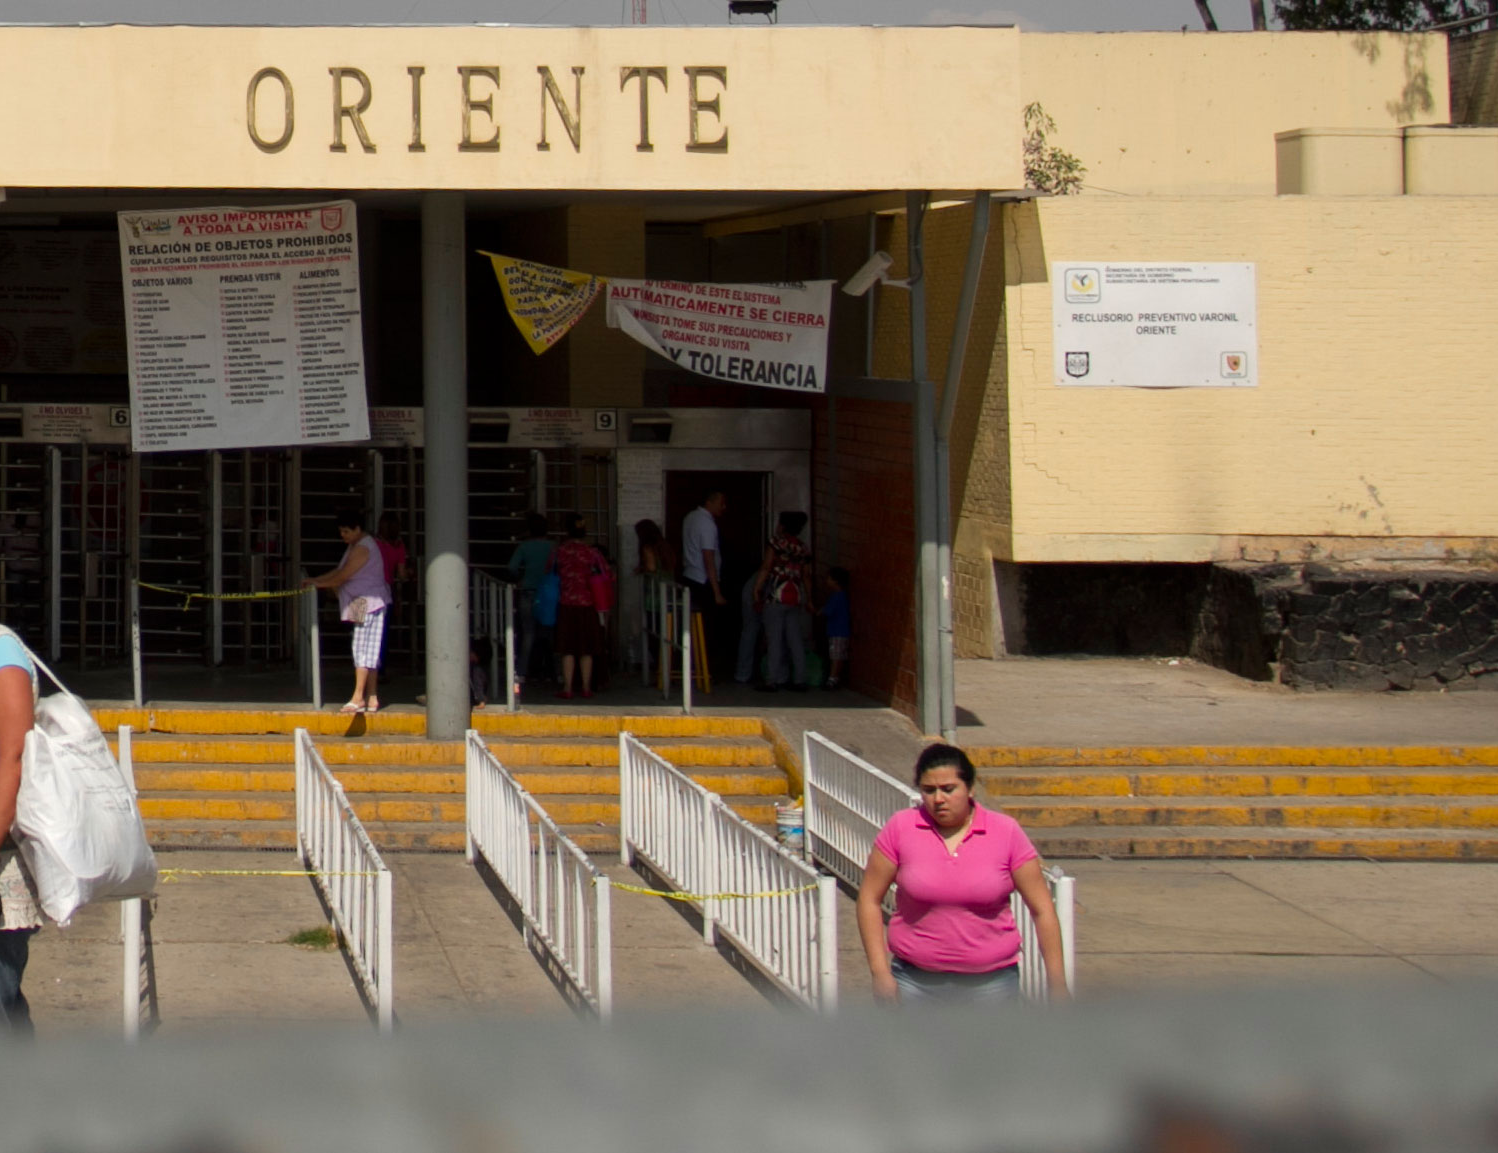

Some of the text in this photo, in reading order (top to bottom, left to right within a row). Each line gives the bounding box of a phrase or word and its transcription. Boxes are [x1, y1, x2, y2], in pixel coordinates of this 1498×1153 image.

[246, 65, 730, 153] ORIENTE
[177, 210, 312, 225] AVISO IMPORTANTE
[183, 226, 192, 236] A
[196, 224, 233, 235] TODA
[238, 222, 254, 233] LA
[128, 241, 191, 256] RELACIÓN
[195, 242, 212, 253] DE
[215, 238, 273, 252] OBJETOS
[276, 232, 353, 248] PROHIBIDOS
[254, 272, 282, 282] VESTIR
[299, 268, 340, 280] ALIMENTOS
[132, 276, 193, 288] OBJETOS VARIOS
[695, 285, 706, 296] DE
[709, 287, 731, 300] ESTE
[732, 291, 742, 300] EL
[744, 292, 781, 306] SISTEMA
[749, 308, 768, 320] SE
[772, 310, 825, 326] CIERRA
[1072, 313, 1238, 323] RECLUSORIO PREVENTIVO VARONIL
[672, 316, 792, 343] TOME SUS PRECAUCIONES Y
[1136, 326, 1177, 336] ORIENTE
[662, 329, 750, 352] ORGANICE SU VISITA
[114, 409, 128, 424] 6
[599, 414, 612, 428] 9
